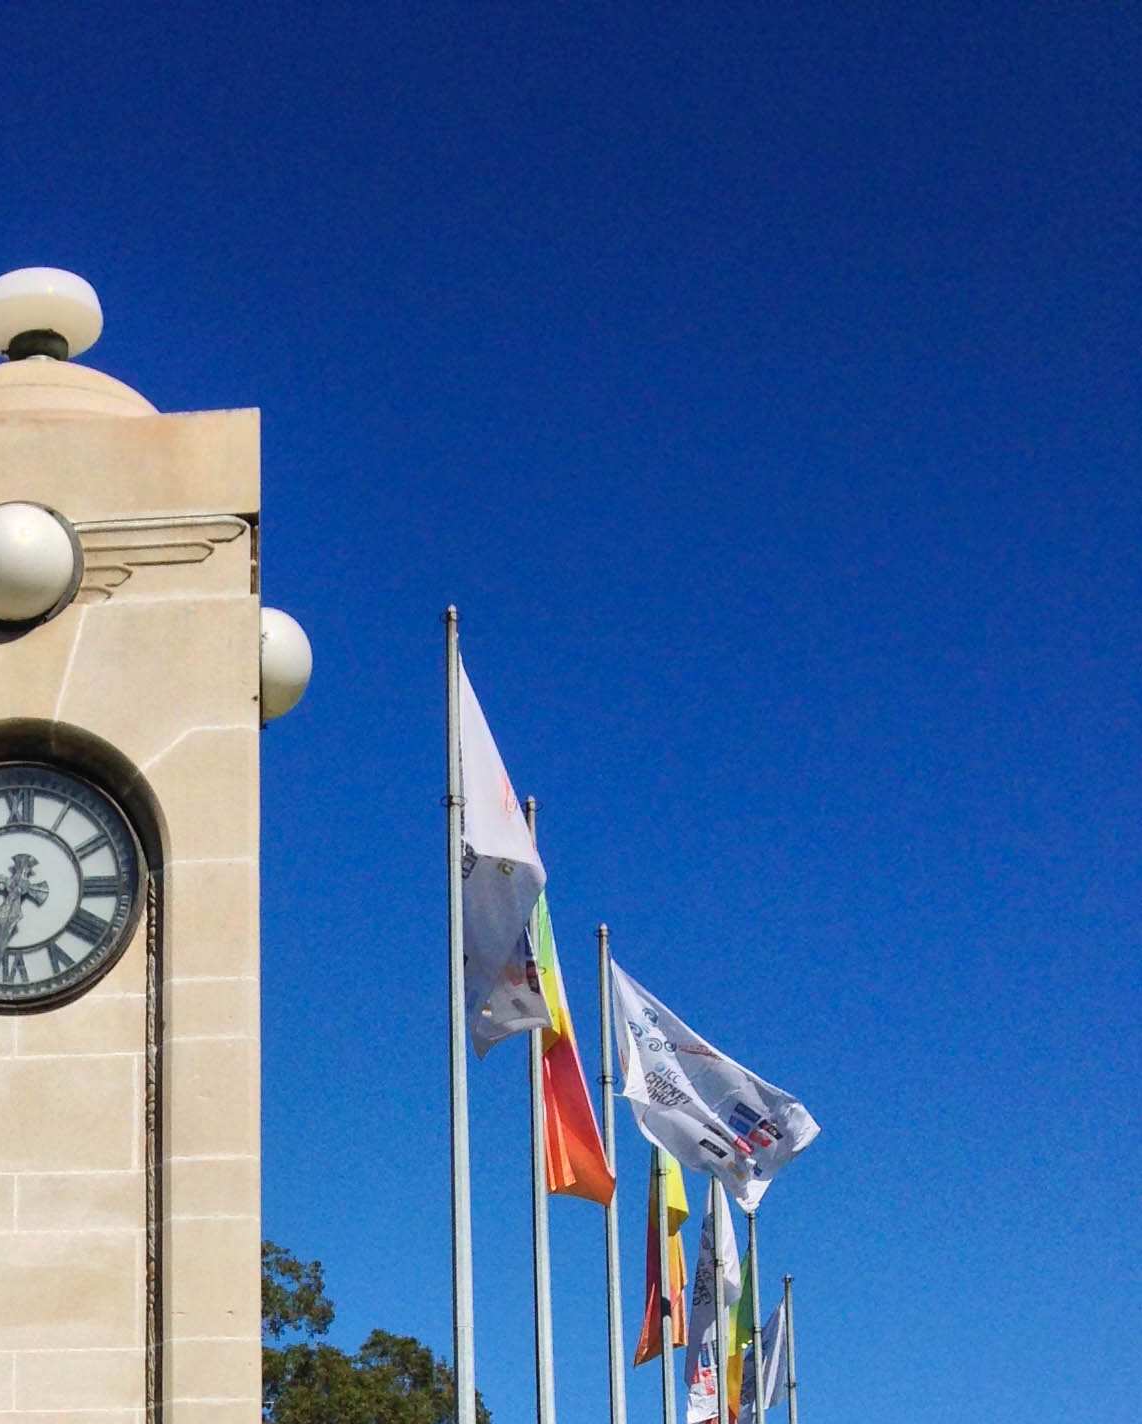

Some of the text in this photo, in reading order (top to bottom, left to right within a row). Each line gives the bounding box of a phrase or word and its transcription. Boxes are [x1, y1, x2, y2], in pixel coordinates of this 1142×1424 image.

[5, 789, 34, 825] XII
[645, 1071, 692, 1105] CRICKET
[664, 1068, 681, 1084] ICC
[647, 1086, 678, 1107] ORLD
